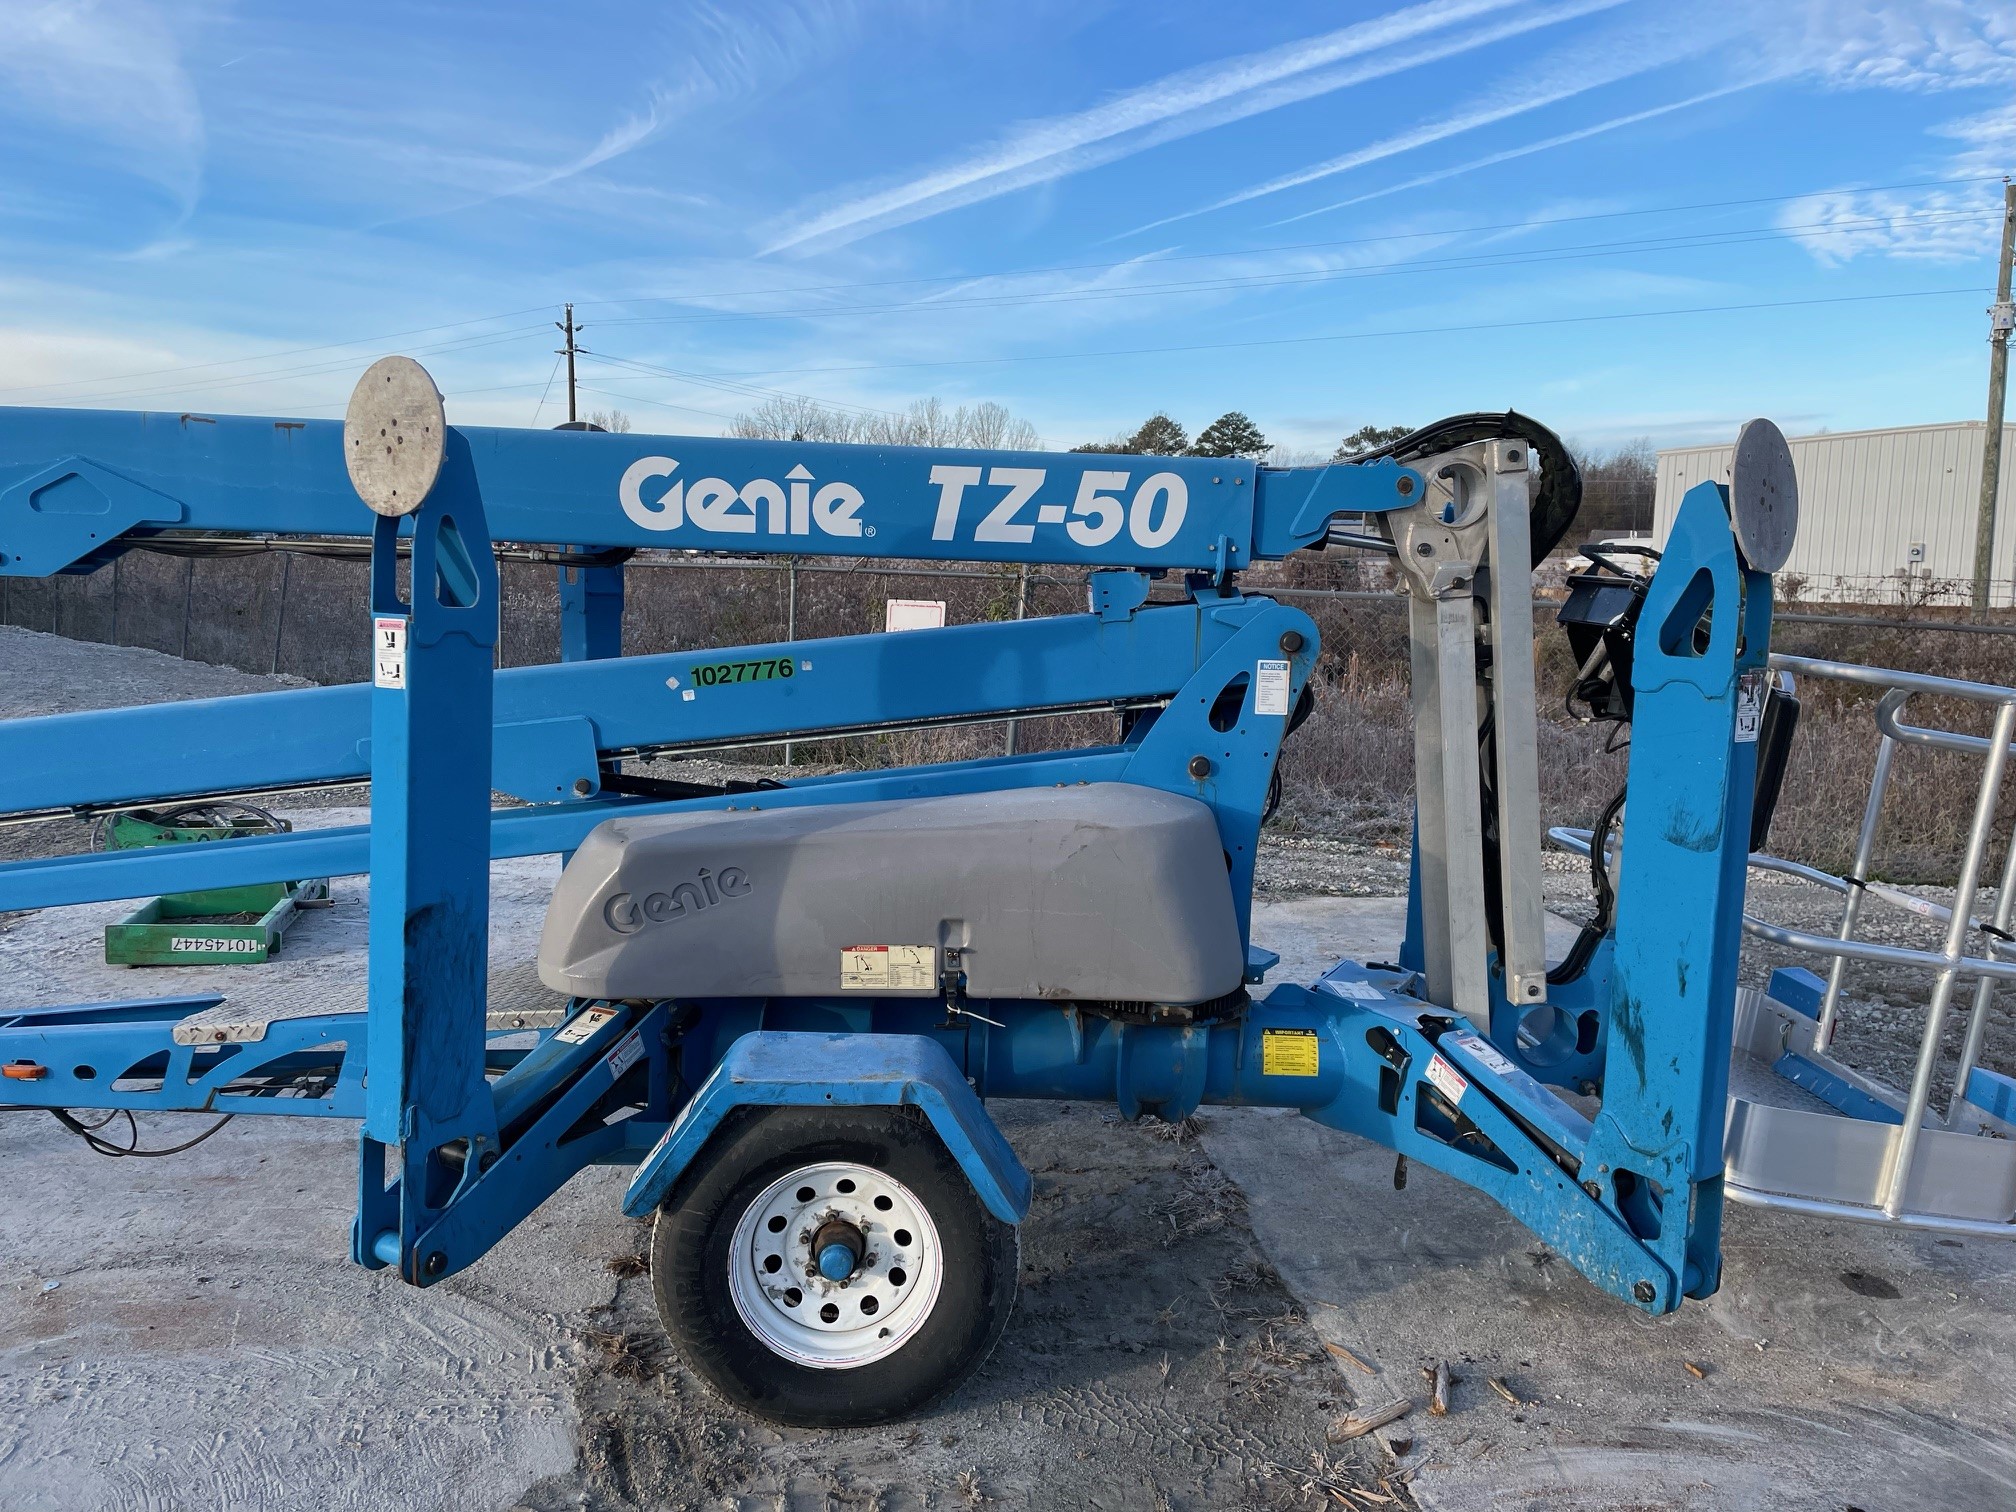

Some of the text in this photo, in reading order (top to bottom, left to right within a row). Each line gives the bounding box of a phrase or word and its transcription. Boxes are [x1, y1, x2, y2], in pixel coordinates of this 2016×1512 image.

[928, 465, 1189, 548] TZ-50
[690, 658, 794, 687] 1027776
[603, 867, 753, 935] Genie
[173, 938, 255, 952] 10145447
